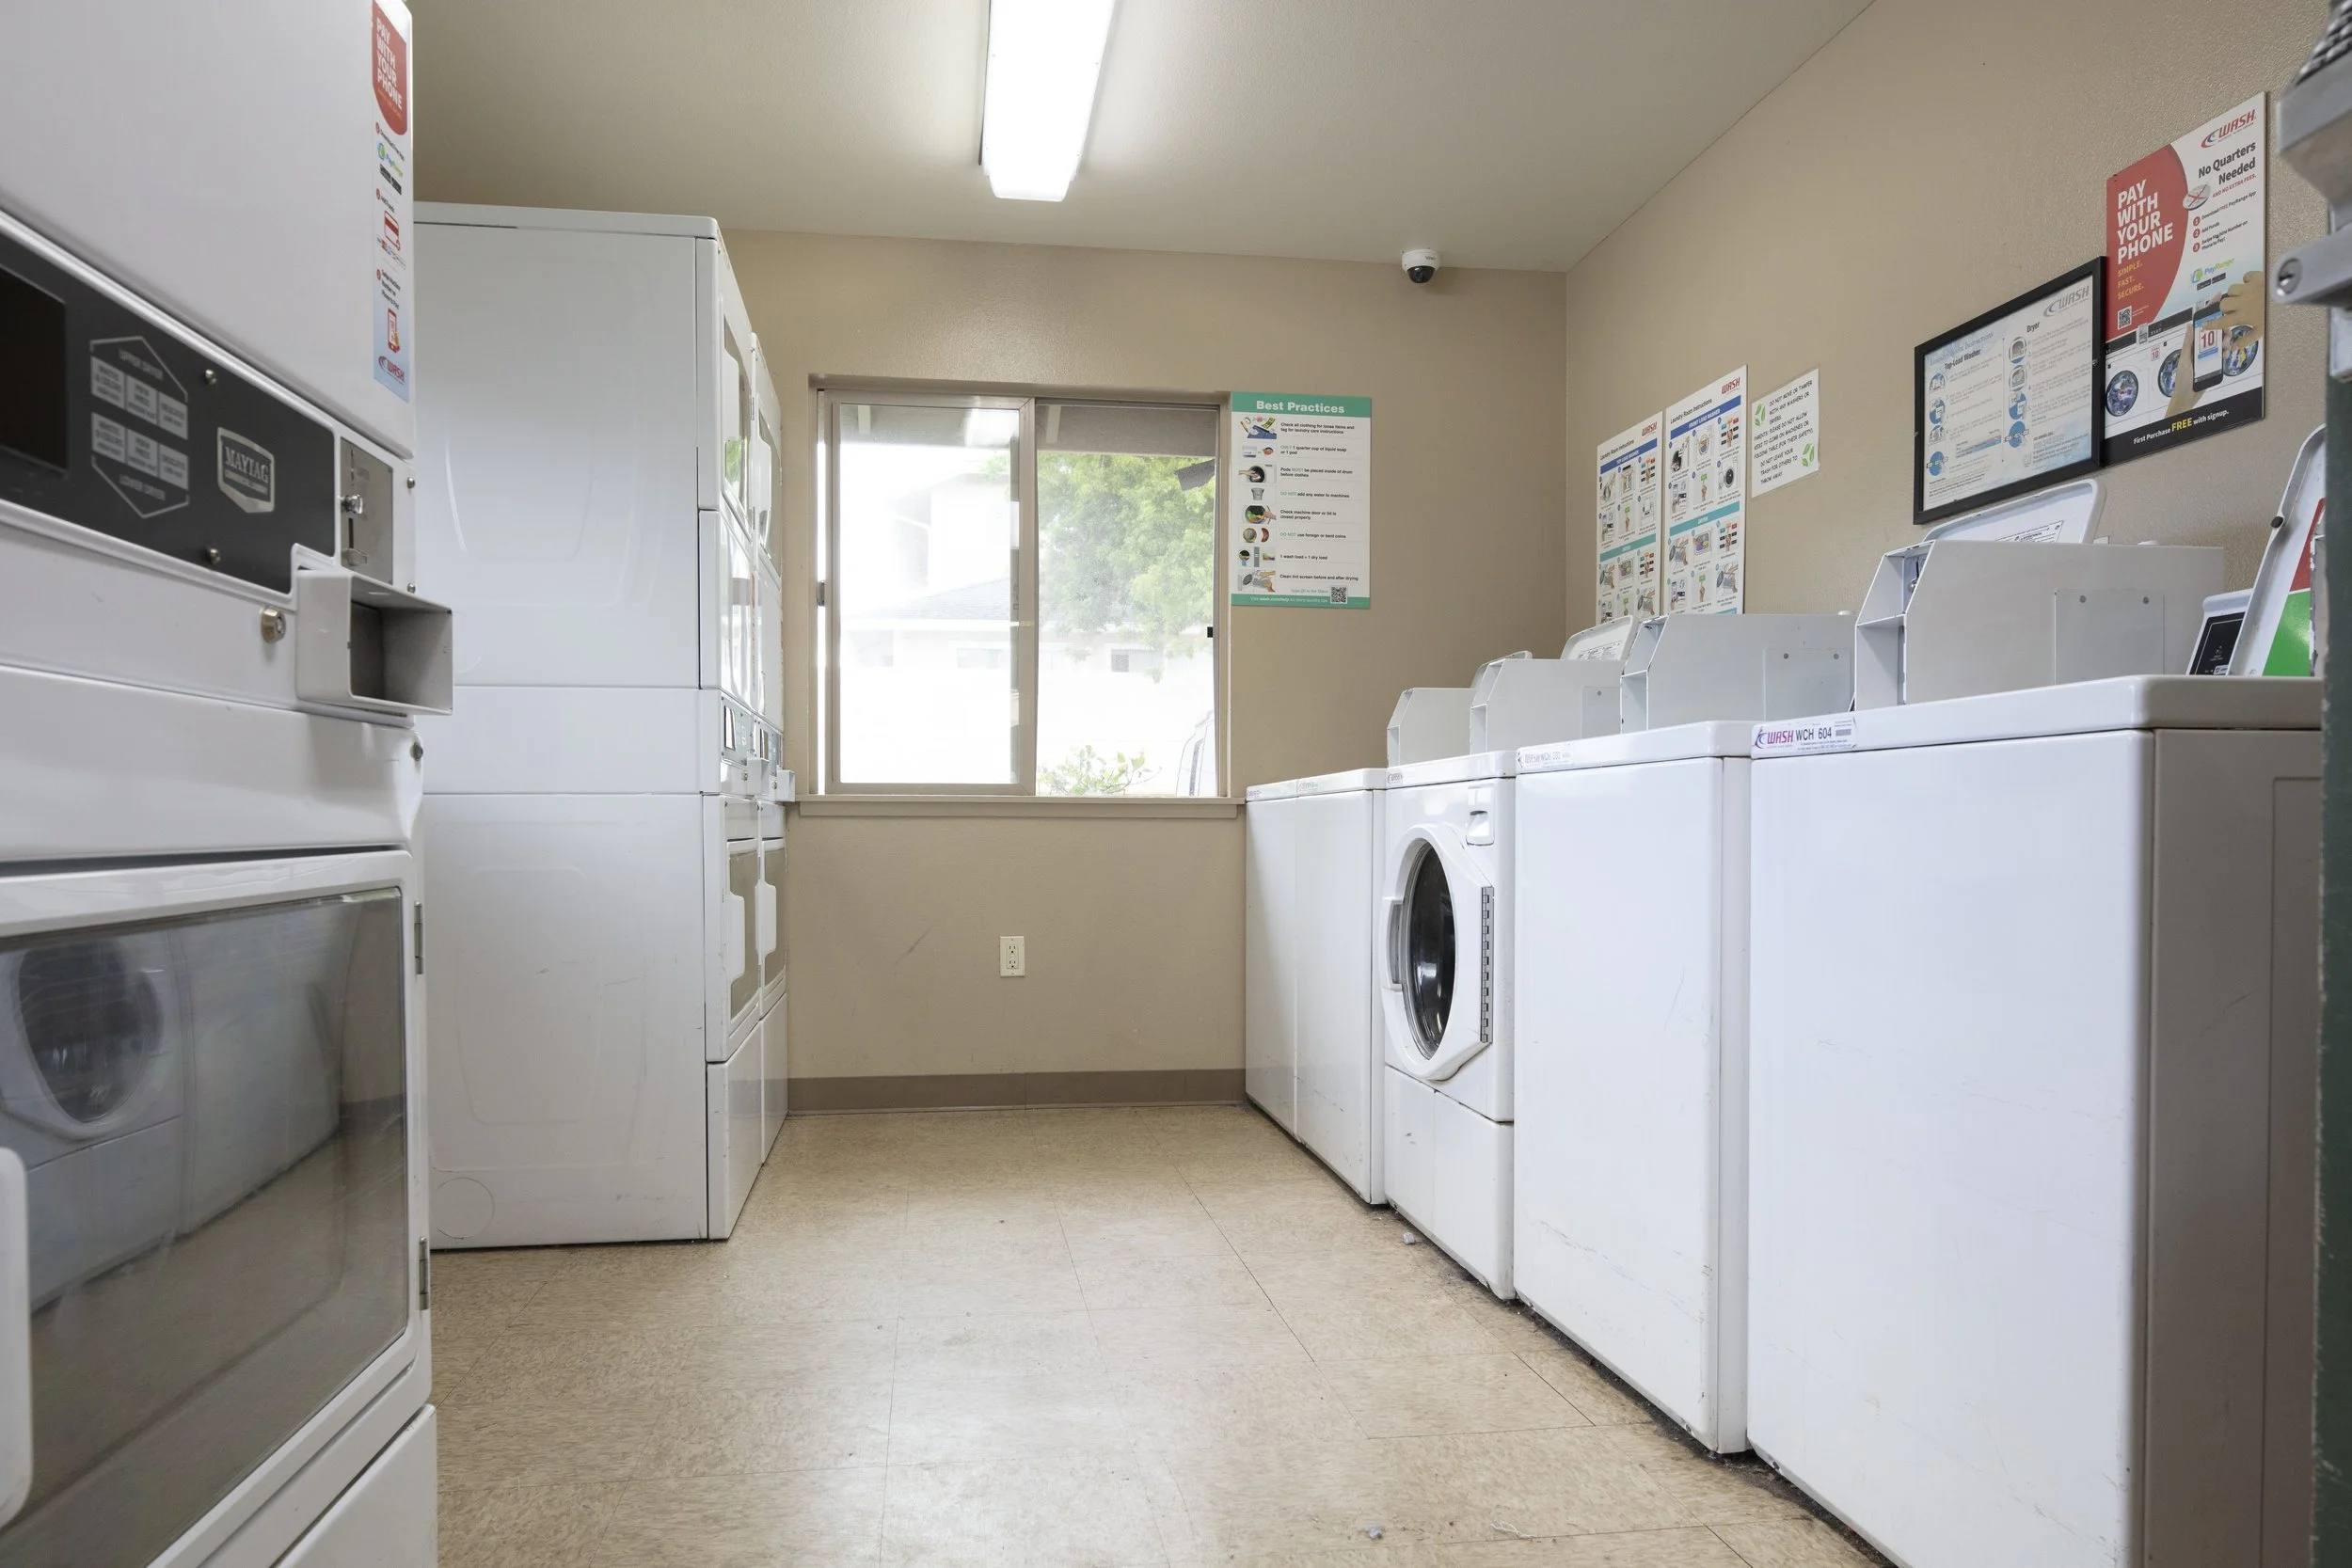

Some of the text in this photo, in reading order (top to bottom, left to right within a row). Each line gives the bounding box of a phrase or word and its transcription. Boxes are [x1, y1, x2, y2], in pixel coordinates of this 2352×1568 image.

[377, 18, 389, 44] PAY
[377, 33, 395, 69] WITH
[377, 51, 397, 87] YOUR
[377, 68, 403, 110] PHONE
[2219, 109, 2255, 138] WASH
[2199, 142, 2256, 178] No Quarters
[2218, 157, 2256, 184] Needed
[2230, 180, 2243, 190] EXTRA
[2244, 173, 2256, 182] FEES.
[2118, 179, 2146, 210] PAY
[2118, 192, 2158, 228] WITH
[2201, 209, 2218, 220] Download
[2229, 196, 2248, 207] PayRange
[2117, 211, 2161, 245] YOUR
[2201, 236, 2212, 245] Swipe
[2213, 230, 2227, 240] Machine
[2228, 223, 2242, 232] Number
[2118, 222, 2173, 264] PHONE
[2118, 260, 2142, 277] SIMPLE.
[2204, 258, 2234, 275] PayRange
[2118, 276, 2136, 289] FAST.
[2118, 282, 2144, 300] SECURE.
[2058, 285, 2090, 309] WASH
[2026, 322, 2040, 333] Dryer
[2201, 330, 2215, 348] 10
[1945, 349, 1981, 370] Top-Load Washer
[2152, 350, 2159, 360] 10
[388, 360, 405, 383] WASH
[1722, 377, 1740, 394] WASH
[1256, 400, 1345, 414] Best Practices
[1670, 398, 1712, 424] Laundry Room Instructions
[2134, 409, 2230, 444] First Purchase FREE with signup.
[225, 446, 268, 483] MAYTAG
[1767, 727, 1832, 744] WASH WCH 604
